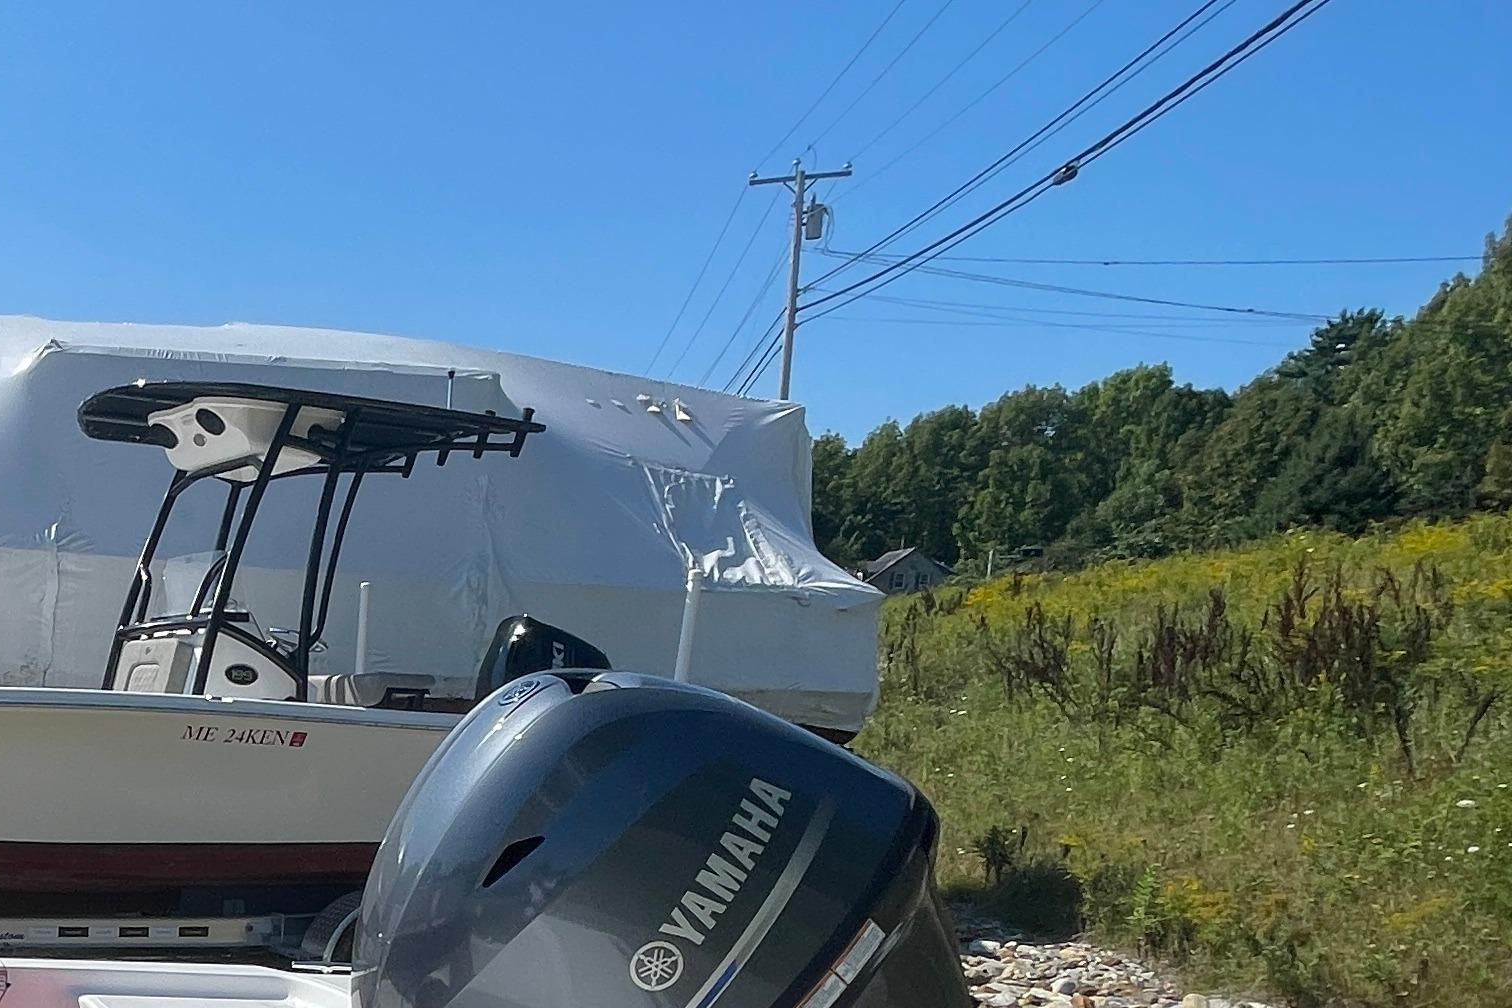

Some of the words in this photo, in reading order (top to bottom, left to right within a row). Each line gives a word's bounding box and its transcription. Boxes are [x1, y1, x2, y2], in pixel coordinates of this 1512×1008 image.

[180, 725, 219, 742] ME
[223, 728, 290, 746] 24KEN
[658, 777, 792, 946] YAMAHA
